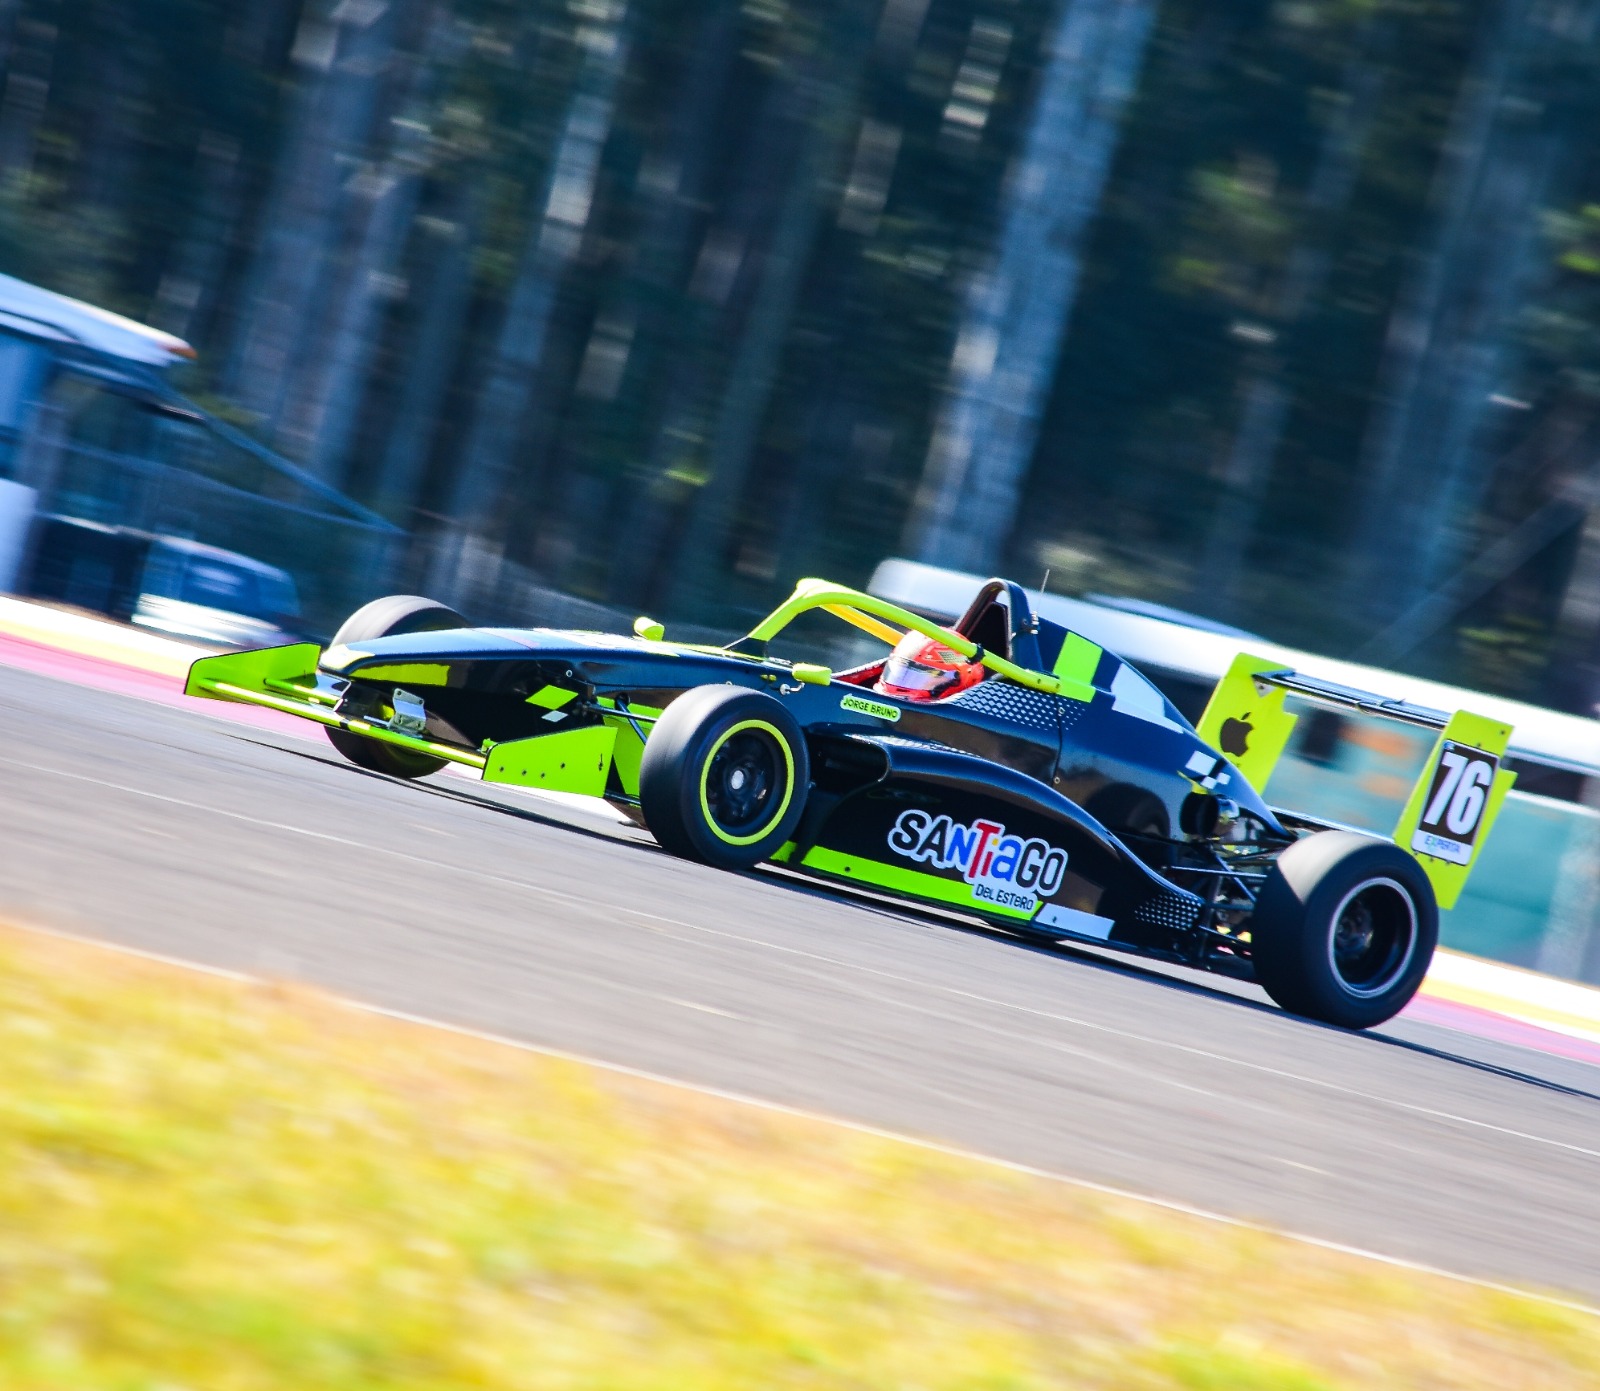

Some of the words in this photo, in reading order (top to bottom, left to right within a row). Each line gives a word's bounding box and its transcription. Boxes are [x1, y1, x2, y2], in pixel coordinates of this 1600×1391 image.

[843, 698, 870, 711] JORGE
[870, 705, 898, 718] BRUNO
[1423, 751, 1493, 835] 76
